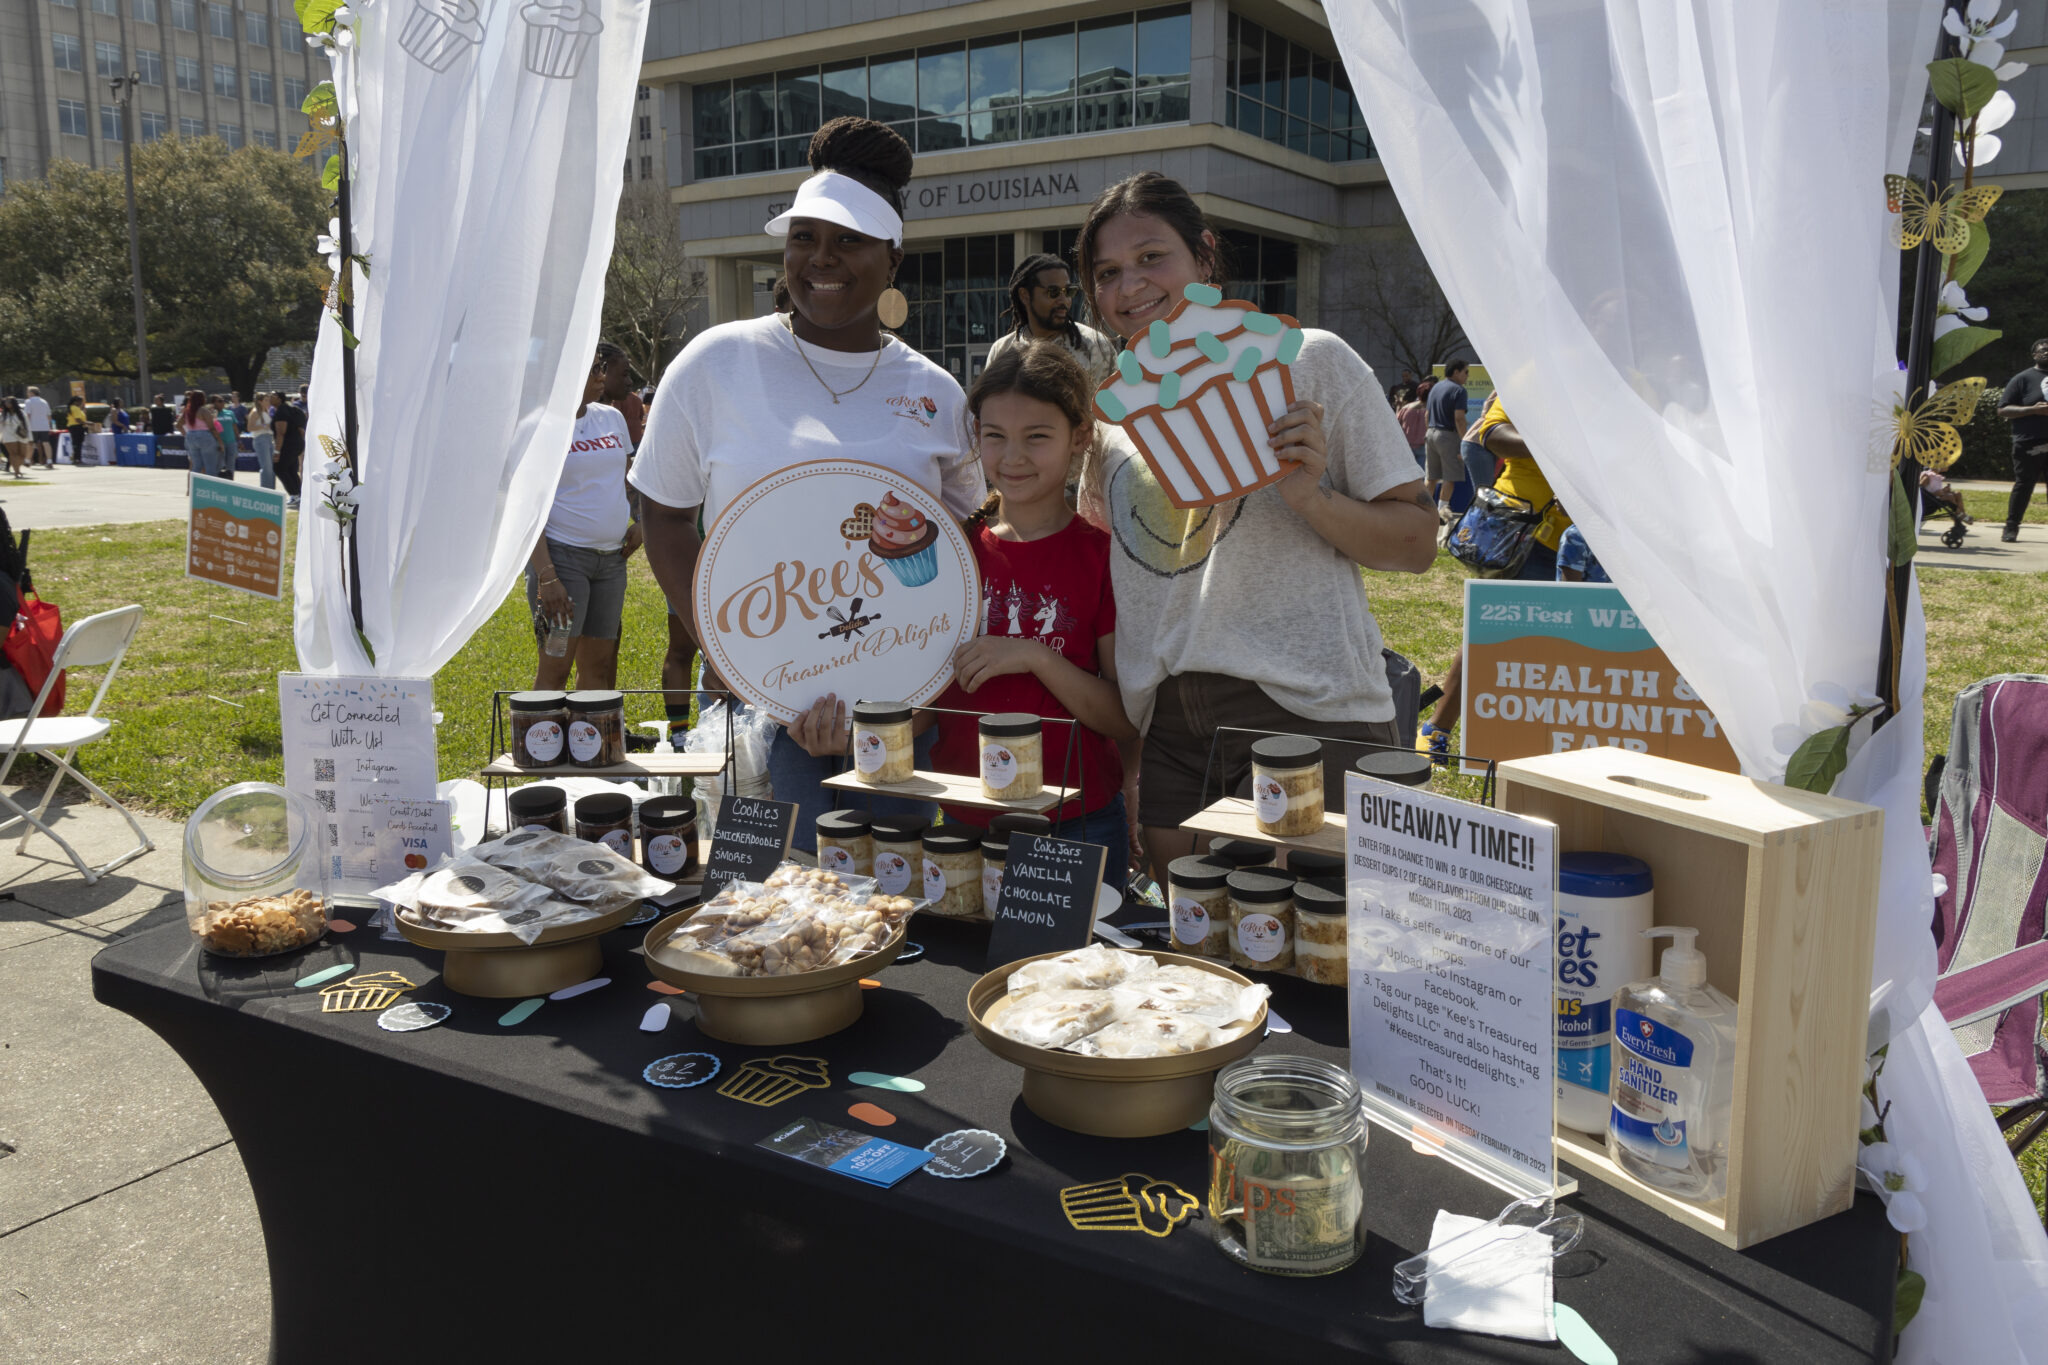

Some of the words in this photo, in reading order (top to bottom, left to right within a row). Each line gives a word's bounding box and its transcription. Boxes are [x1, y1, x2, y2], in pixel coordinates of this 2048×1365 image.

[919, 185, 949, 209] OF
[957, 173, 1080, 205] LOUISIANA
[231, 495, 281, 516] WELCOME
[1480, 604, 1522, 622] 225
[1526, 605, 1574, 624] Fest
[762, 641, 861, 691] Treasured
[862, 612, 952, 657] Delights
[1496, 661, 1660, 699] HEALTH
[311, 700, 335, 723] Get
[336, 702, 401, 726] Connected
[1474, 693, 1719, 738] COMMUNITY
[331, 725, 362, 748] With
[365, 730, 383, 751] Us!
[355, 758, 398, 777] Instagram
[390, 806, 434, 818] Credit/Debit
[732, 798, 779, 820] Cookies
[387, 819, 406, 831] Cards
[1360, 792, 1462, 850] GIVEAWAY
[1467, 819, 1535, 872] TIME!!
[401, 837, 428, 849] VISA
[713, 829, 782, 849] SNICKERDOODLE
[1033, 837, 1056, 854] Cake
[1057, 843, 1082, 857] Jars
[710, 868, 747, 881] BUTTER
[1012, 862, 1073, 885] VANILLA
[1358, 836, 1379, 852] ENTER
[1378, 842, 1392, 856] FOR
[1392, 846, 1398, 857] A
[1398, 847, 1424, 867] CHANCE
[1425, 857, 1434, 870] TO
[1435, 860, 1448, 875] WIN
[1451, 864, 1457, 877] 8
[1459, 868, 1469, 880] OF
[1470, 871, 1485, 885] OUR
[1486, 874, 1533, 901] CHEESECAKE
[1004, 885, 1072, 909] CHOCOLATE
[1354, 854, 1381, 872] DESSERT
[1382, 862, 1399, 879] CUPS
[1402, 870, 1408, 882] 2
[1409, 872, 1418, 884] OF
[1418, 875, 1437, 890] EACH
[1437, 880, 1464, 899] FLAVOR
[1470, 890, 1490, 908] FROM
[1492, 896, 1507, 911] OUR
[1508, 901, 1528, 919] SALE
[1528, 908, 1540, 924] ON
[1409, 891, 1434, 910] MARCH
[1001, 905, 1056, 928] ALMOND
[1363, 900, 1371, 913] 1.
[1379, 904, 1402, 923] Take
[1404, 916, 1410, 926] a
[1413, 920, 1441, 937] selfie
[1443, 930, 1467, 948] with
[1470, 939, 1491, 955] one
[1494, 947, 1508, 962] of
[1510, 953, 1531, 970] our
[1432, 945, 1467, 968] props.
[1386, 946, 1423, 970] Upload
[1425, 961, 1434, 974] it
[1435, 965, 1447, 979] to
[1450, 970, 1506, 1002] Instagram
[1509, 995, 1523, 1008] or
[1424, 979, 1479, 1011] Facebook.
[1553, 998, 1582, 1016] us
[1363, 973, 1372, 987] 3.
[1375, 977, 1393, 998] Tag
[1395, 988, 1412, 1002] our
[1414, 994, 1440, 1015] page
[1442, 1004, 1476, 1030] "Kee's
[1477, 1019, 1538, 1056] Treasured
[1373, 995, 1414, 1023] Delights
[1417, 1014, 1441, 1032] LLC"
[1443, 1026, 1465, 1045] and
[1466, 1036, 1490, 1055] also
[1492, 1045, 1541, 1080] hashtag
[1621, 1026, 1677, 1062] EveryFresh
[1418, 1058, 1452, 1083] That's
[1455, 1074, 1467, 1091] It!
[1629, 1057, 1663, 1085] HAND
[1409, 1074, 1444, 1099] GOOD
[1447, 1091, 1481, 1118] LUCK!
[1619, 1066, 1679, 1106] SANITIZER
[1375, 1081, 1396, 1099] WINNER
[1396, 1091, 1409, 1106] WILL
[1409, 1097, 1417, 1109] BE
[1417, 1101, 1444, 1123] SELECTED
[1445, 1116, 1454, 1128] ON
[1454, 1120, 1480, 1140] TUESDAY
[1480, 1133, 1512, 1156] FEBRUARY
[1512, 1148, 1529, 1164] 28TH
[1529, 1157, 1547, 1174] 2023
[850, 1147, 875, 1162] ENJOY
[850, 1157, 875, 1170] 10%
[872, 1144, 892, 1158] OFF
[1208, 1143, 1297, 1224] Tips
